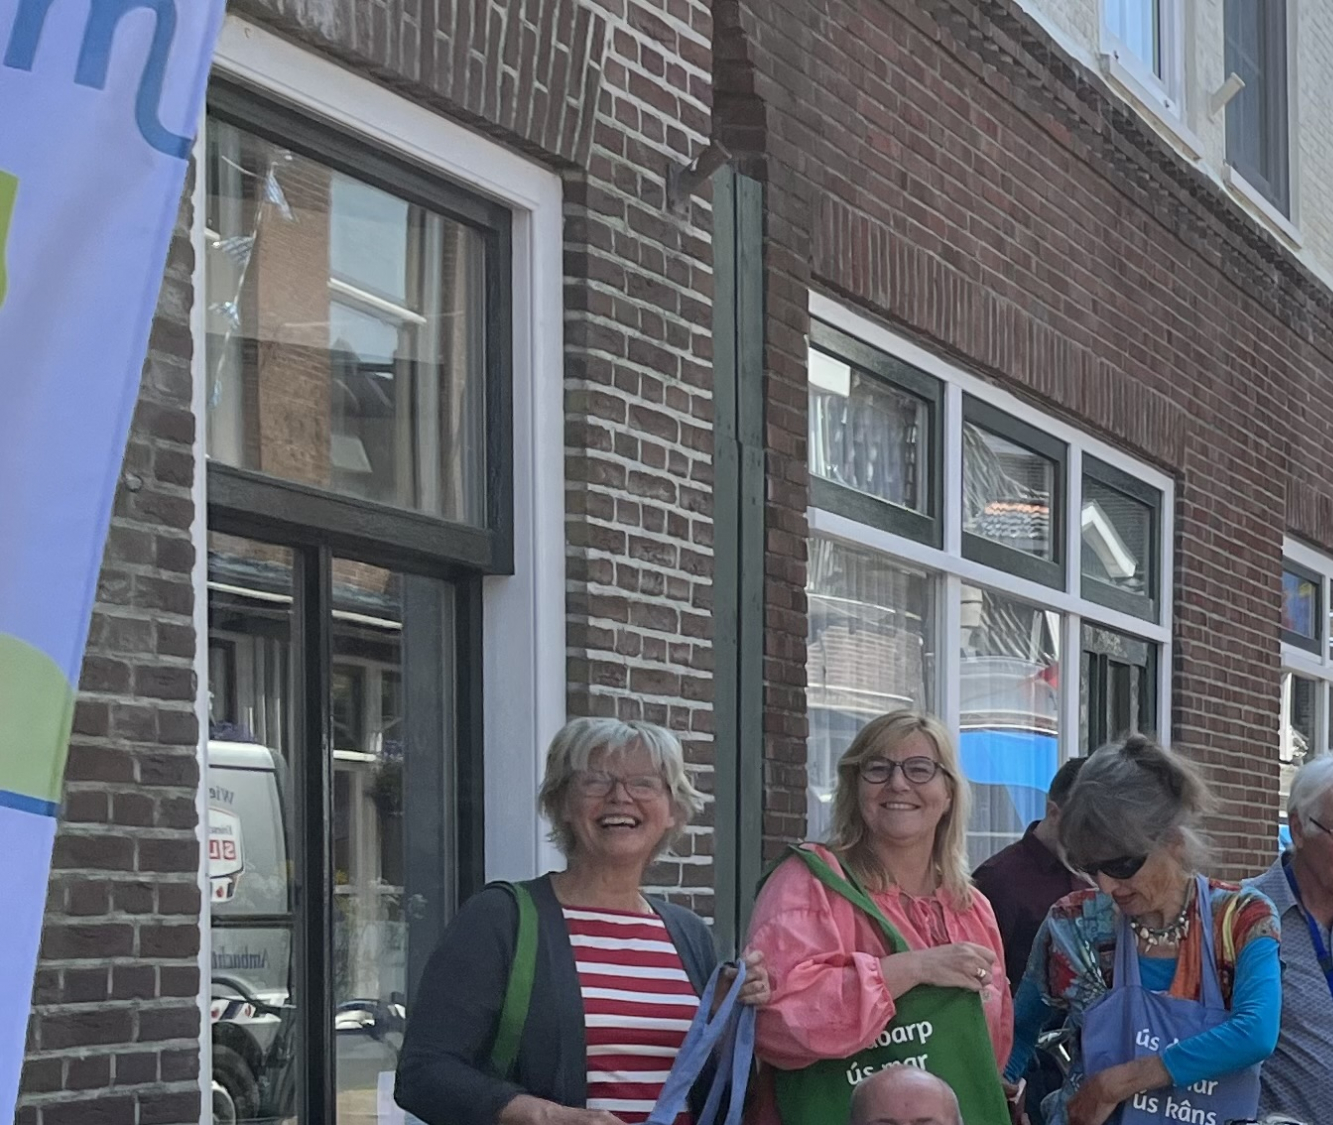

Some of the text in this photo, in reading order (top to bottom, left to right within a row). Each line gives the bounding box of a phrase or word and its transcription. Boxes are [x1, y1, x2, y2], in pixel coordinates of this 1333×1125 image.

[1135, 1028, 1160, 1051] ús
[846, 1062, 874, 1086] ús
[1132, 1089, 1159, 1114] ús
